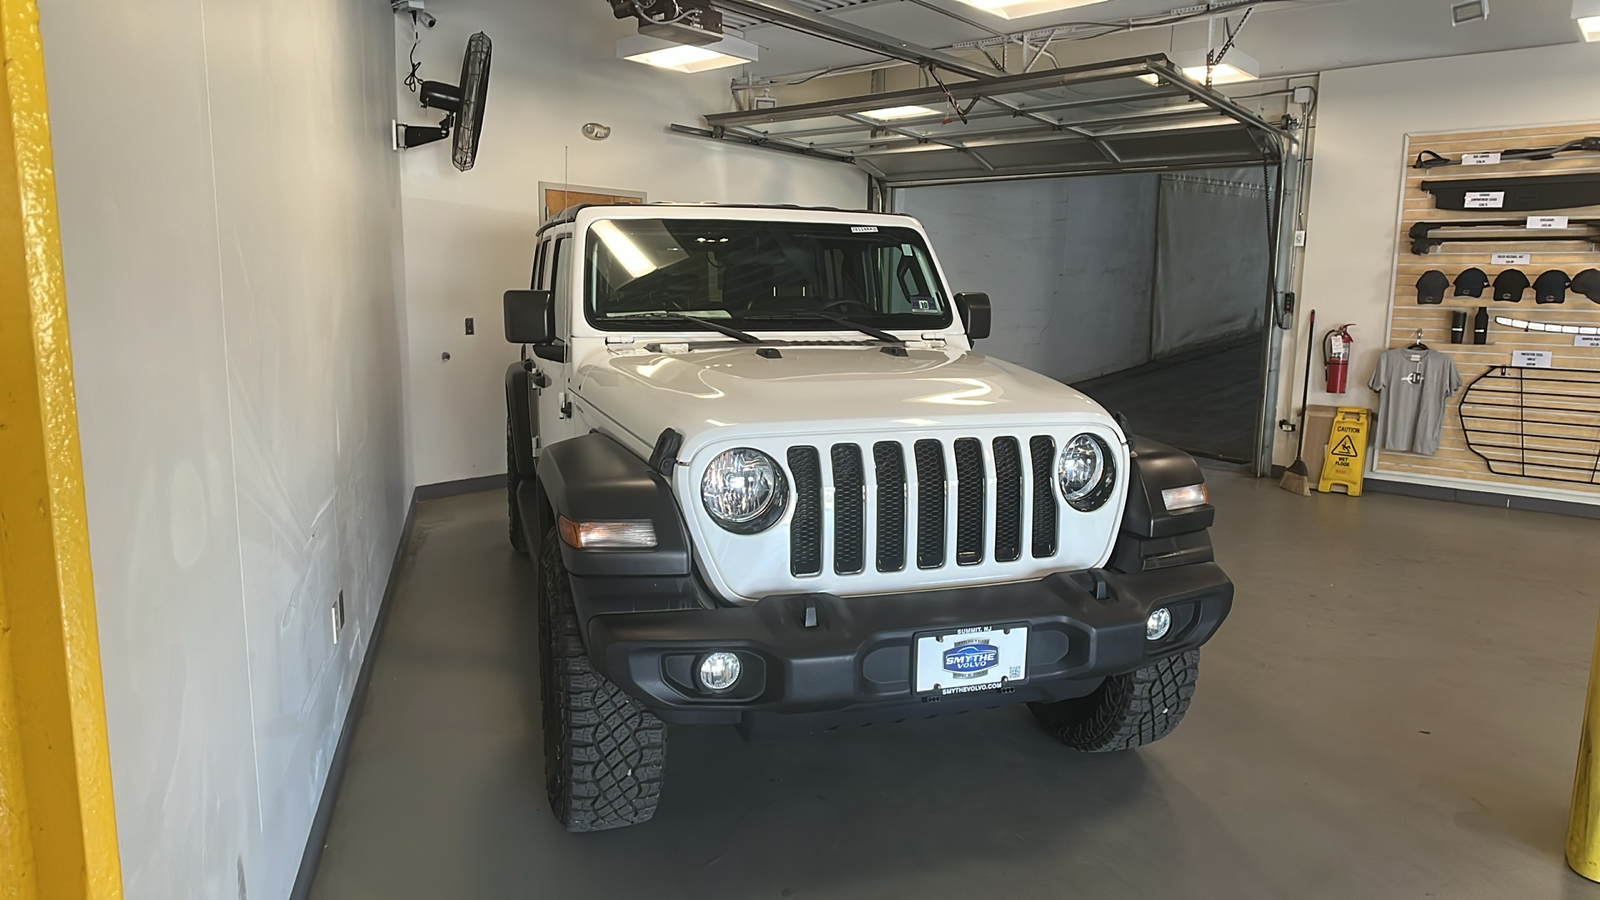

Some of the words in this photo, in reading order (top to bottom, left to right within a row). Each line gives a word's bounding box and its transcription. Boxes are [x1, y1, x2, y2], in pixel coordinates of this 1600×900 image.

[945, 653, 995, 665] SMYTHE
[957, 661, 987, 669] VOLVO
[942, 683, 1002, 695] SMYTHEVOLVO.COM
